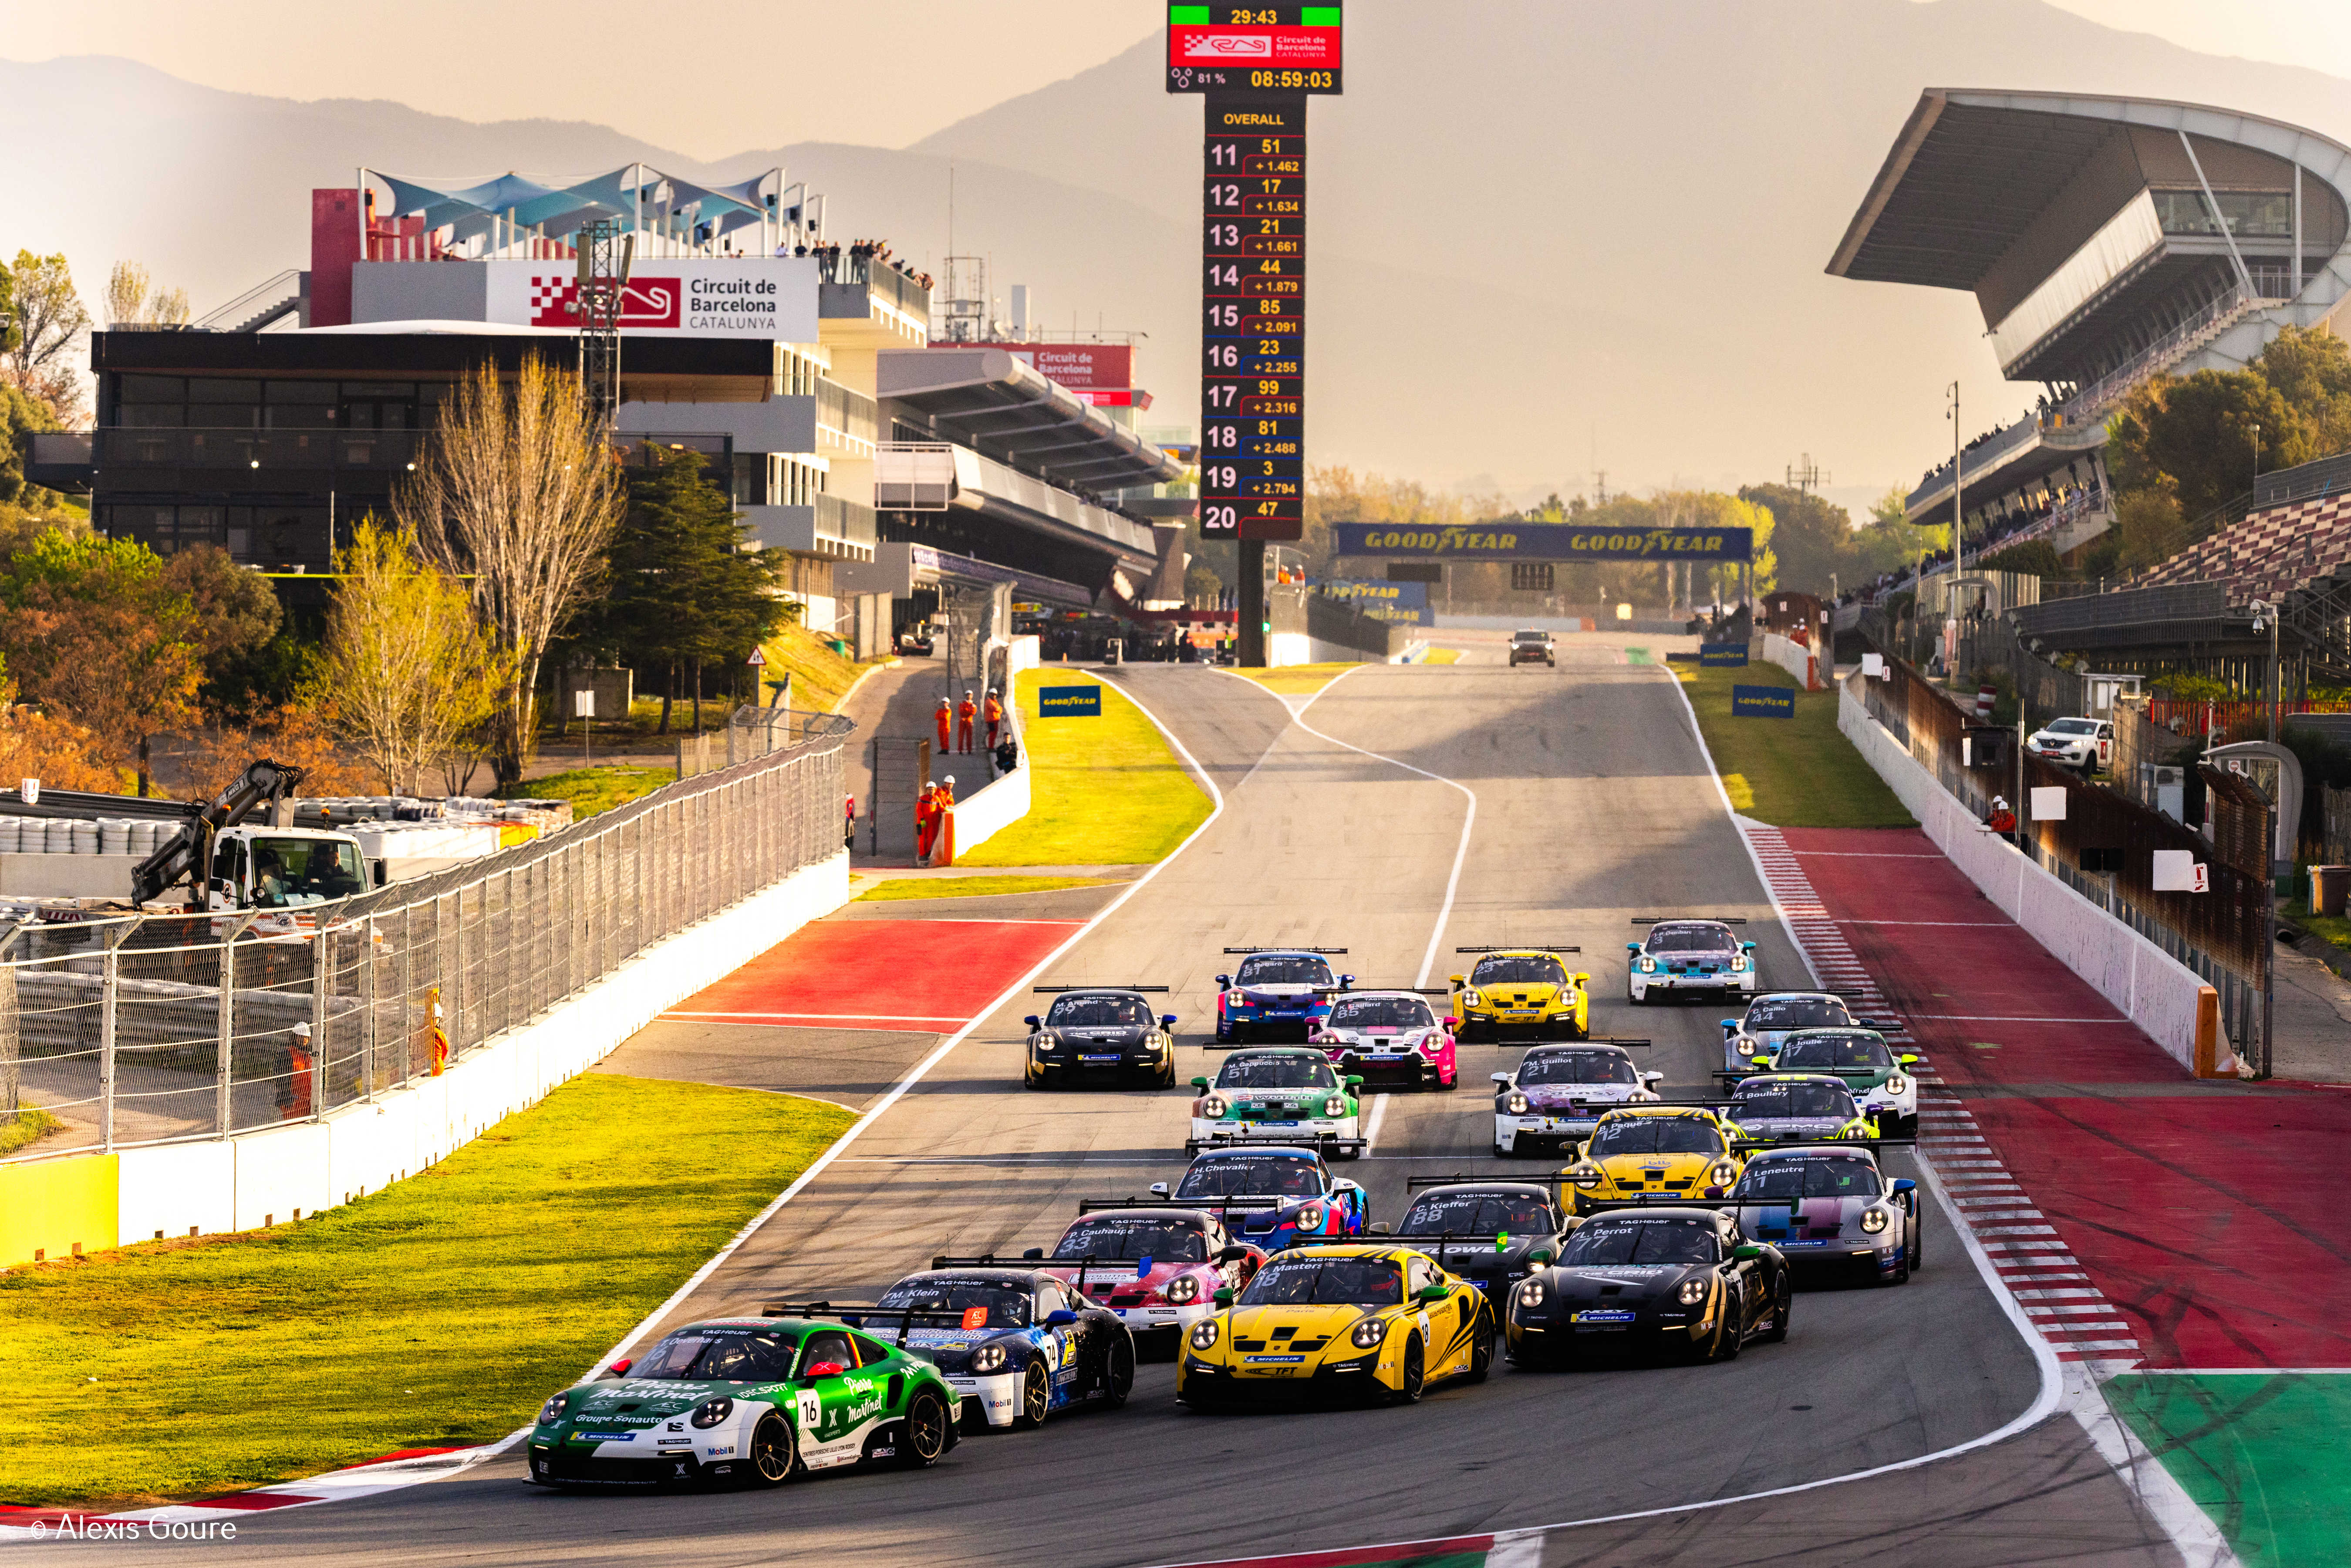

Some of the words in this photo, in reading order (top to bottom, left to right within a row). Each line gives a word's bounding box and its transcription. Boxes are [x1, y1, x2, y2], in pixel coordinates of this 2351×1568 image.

[1231, 10, 1277, 24] 29:43
[1197, 73, 1211, 83] 81
[1215, 73, 1226, 84] %
[1251, 71, 1332, 88] 08:59:03
[1224, 114, 1284, 125] OVERALL
[1262, 139, 1280, 154] 51
[1211, 144, 1236, 166] 11
[1267, 161, 1299, 172] 1.462
[1262, 179, 1282, 193] 17
[1211, 185, 1239, 206] 12
[1267, 201, 1299, 212] 1.634
[1261, 219, 1279, 234] 21
[1210, 225, 1239, 246] 13
[1267, 241, 1297, 252] 1.661
[1260, 260, 1281, 274] 44
[1210, 265, 1238, 286] 14
[691, 278, 753, 295] Circuit
[755, 278, 776, 295] de
[1266, 281, 1298, 292] 1.879
[691, 297, 776, 313] Barcelona
[1260, 300, 1280, 314] 85
[690, 316, 776, 329] CATALUNYA
[1209, 305, 1238, 327] 15
[1265, 322, 1296, 332] 2.091
[1259, 340, 1279, 354] 23
[1039, 352, 1076, 363] Circuit
[1079, 352, 1093, 363] de
[1208, 345, 1238, 367] 16
[1039, 364, 1093, 374] Barcelona
[1265, 362, 1297, 373] 2.255
[1259, 380, 1279, 395] 99
[1208, 385, 1237, 407] 17
[1265, 402, 1297, 413] 2.316
[1258, 421, 1277, 435] 81
[1208, 425, 1236, 448] 18
[1264, 443, 1296, 453] 2.488
[1263, 461, 1273, 475] 3
[1207, 466, 1236, 488] 19
[1264, 483, 1296, 494] 2.794
[1258, 502, 1278, 516] 47
[1206, 506, 1235, 529] 20
[1365, 527, 1517, 553] GOODYEAR
[1570, 529, 1723, 555] GOODYEAR
[1043, 695, 1096, 707] GOODYEAR
[1738, 697, 1790, 707] GOODYEAR
[1475, 965, 1494, 975] 23
[1054, 1005, 1076, 1017] 99
[1337, 1008, 1359, 1019] 85
[1751, 1012, 1774, 1022] 44
[1784, 1045, 1803, 1057] 17
[1228, 1067, 1249, 1079] 51
[1528, 1064, 1548, 1076] 21
[1602, 1128, 1620, 1141] 12
[1755, 1167, 1805, 1177] Leneutre
[1187, 1174, 1203, 1187] 2
[1742, 1176, 1767, 1191] 11
[1430, 1201, 1471, 1210] Kieffer
[1411, 1209, 1443, 1225] 88
[1594, 1227, 1633, 1237] Perrot
[1059, 1237, 1091, 1253] 33
[1576, 1235, 1607, 1252] 77
[1273, 1264, 1322, 1273] Masters
[1255, 1272, 1281, 1289] 18
[908, 1289, 940, 1297] Klein
[1422, 1323, 1429, 1343] 18
[1046, 1344, 1056, 1366] 74
[625, 1380, 710, 1389] Pierre
[843, 1376, 874, 1396] Pierre
[589, 1388, 714, 1401] Martinet
[847, 1392, 883, 1423] Martinet
[988, 1399, 1006, 1408] Mobil
[803, 1400, 816, 1422] 16
[576, 1414, 611, 1424] Groupe
[708, 1447, 728, 1455] Mobil
